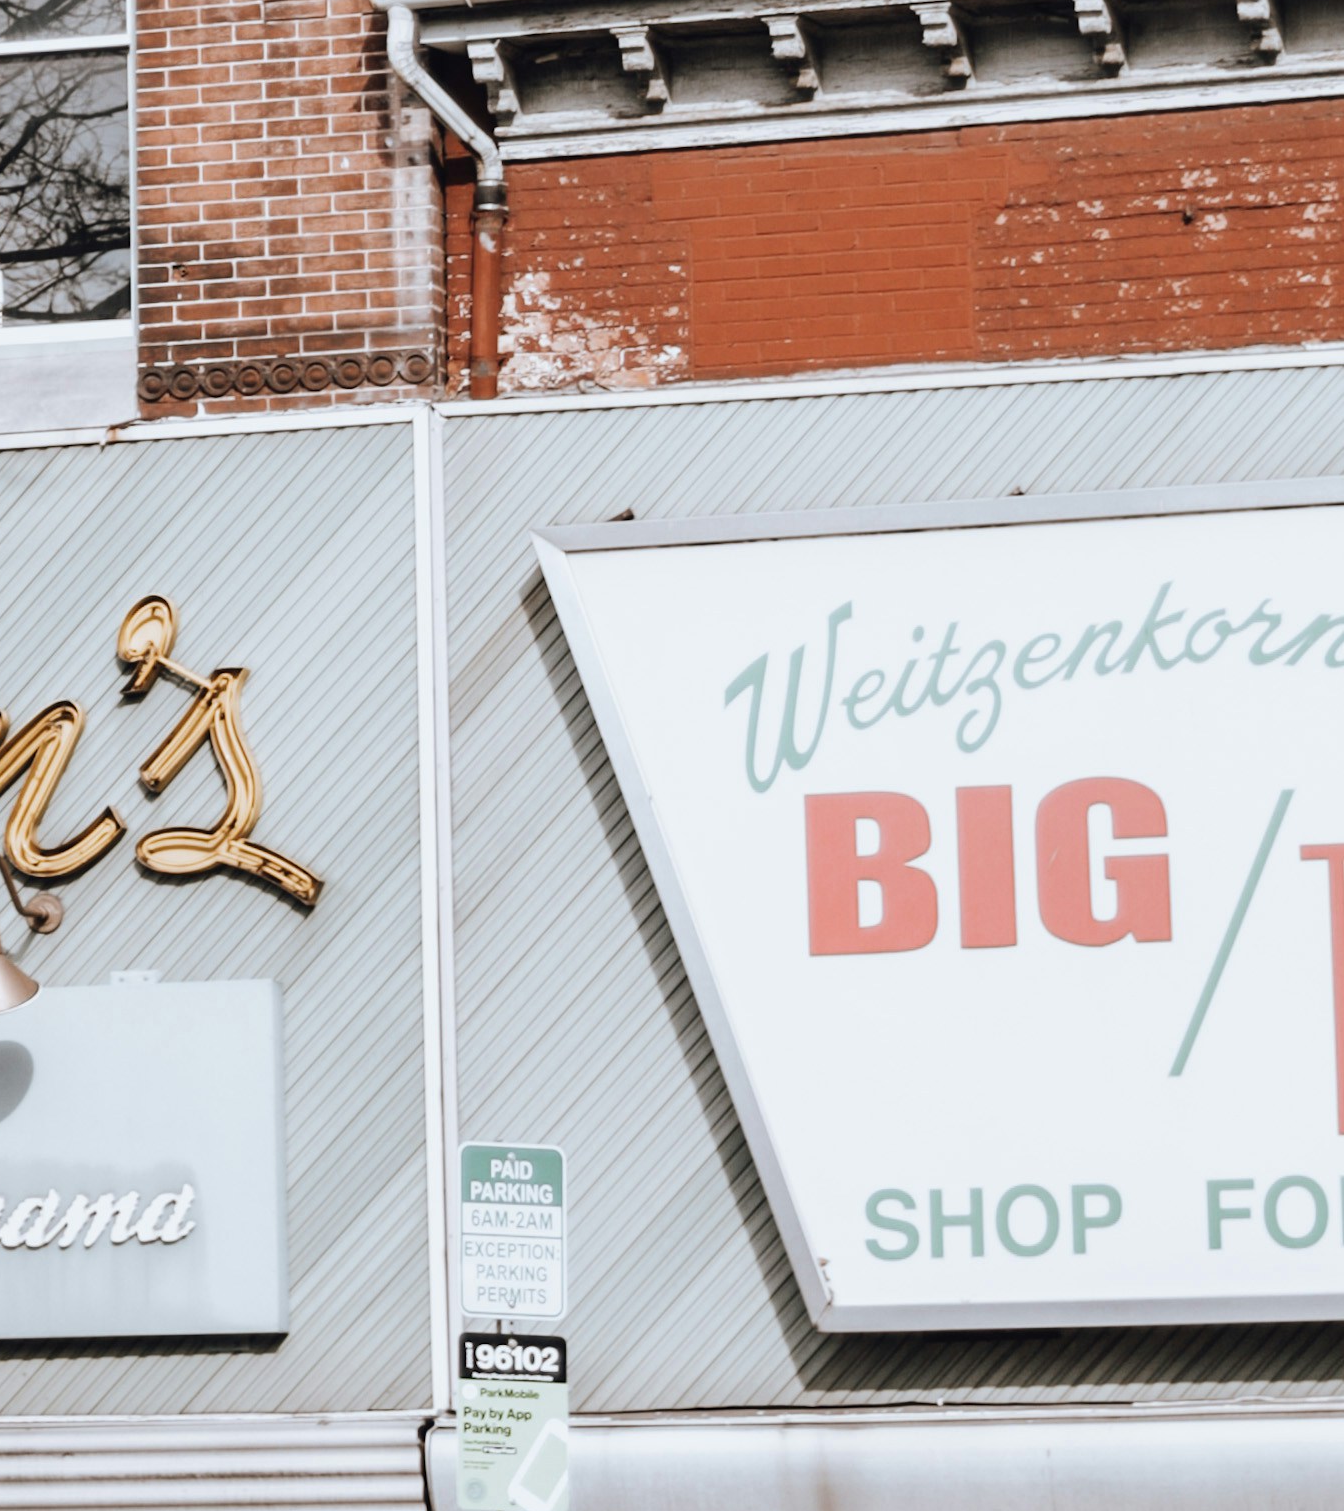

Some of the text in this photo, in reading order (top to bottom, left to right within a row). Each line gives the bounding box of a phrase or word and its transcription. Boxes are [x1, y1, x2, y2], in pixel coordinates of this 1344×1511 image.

[803, 776, 1173, 957] BIG
[490, 1159, 534, 1181] PAID
[469, 1180, 554, 1205] PARKING
[470, 1209, 554, 1231] 6AM-2AM
[864, 1174, 1344, 1262] SHOP FO
[464, 1240, 561, 1262] EXCEPTION:
[476, 1263, 548, 1283] PARKING
[476, 1286, 548, 1305] PERMITS
[474, 1343, 560, 1373] 96102
[479, 1387, 541, 1400] ParkMobile
[463, 1406, 533, 1422] Pay by App
[463, 1422, 513, 1438] Parking
